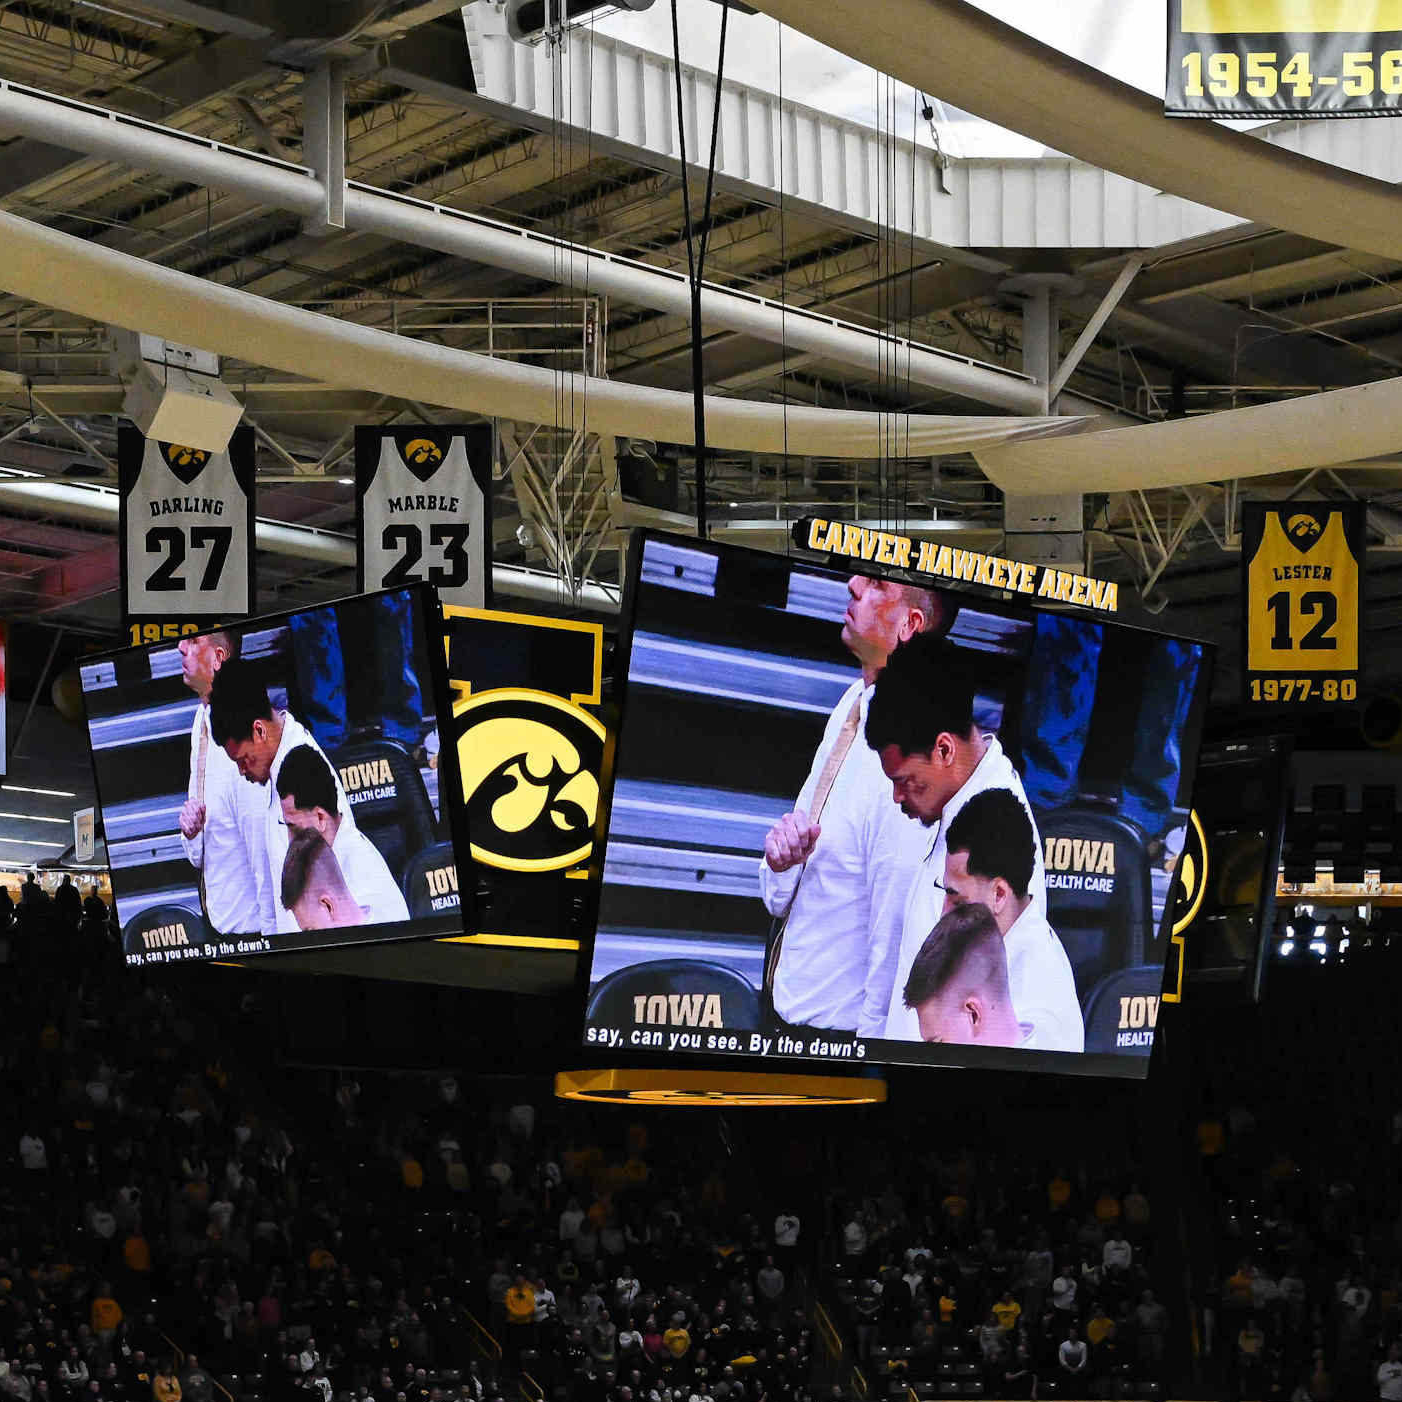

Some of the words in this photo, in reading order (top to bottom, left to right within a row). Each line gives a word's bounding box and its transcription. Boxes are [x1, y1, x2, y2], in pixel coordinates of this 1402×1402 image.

[149, 498, 224, 518] DARLING
[388, 495, 460, 514] MARBLE
[145, 526, 233, 591] 27
[381, 524, 470, 588] 23
[808, 518, 1038, 594] CARVER-HAWKEYE
[1038, 569, 1118, 612] ARENA
[1273, 565, 1333, 582] LESTER
[1267, 591, 1338, 650] 12
[1250, 679, 1357, 701] 1977-80
[340, 759, 395, 792] IOWA
[375, 786, 397, 799] CARE
[1045, 837, 1116, 875] IOWA
[1085, 877, 1115, 893] CARE
[126, 952, 145, 965] say,
[146, 951, 162, 962] can
[165, 949, 181, 962] you
[183, 947, 203, 959] see.
[204, 943, 217, 957] By
[219, 942, 234, 954] the
[237, 938, 271, 953] dawn's
[587, 1027, 624, 1048] say,
[630, 1029, 663, 1046] can
[668, 1032, 703, 1051] you
[707, 1034, 743, 1051] see.
[749, 1034, 774, 1057] By
[777, 1035, 804, 1054] the
[809, 1038, 866, 1058] dawn's
